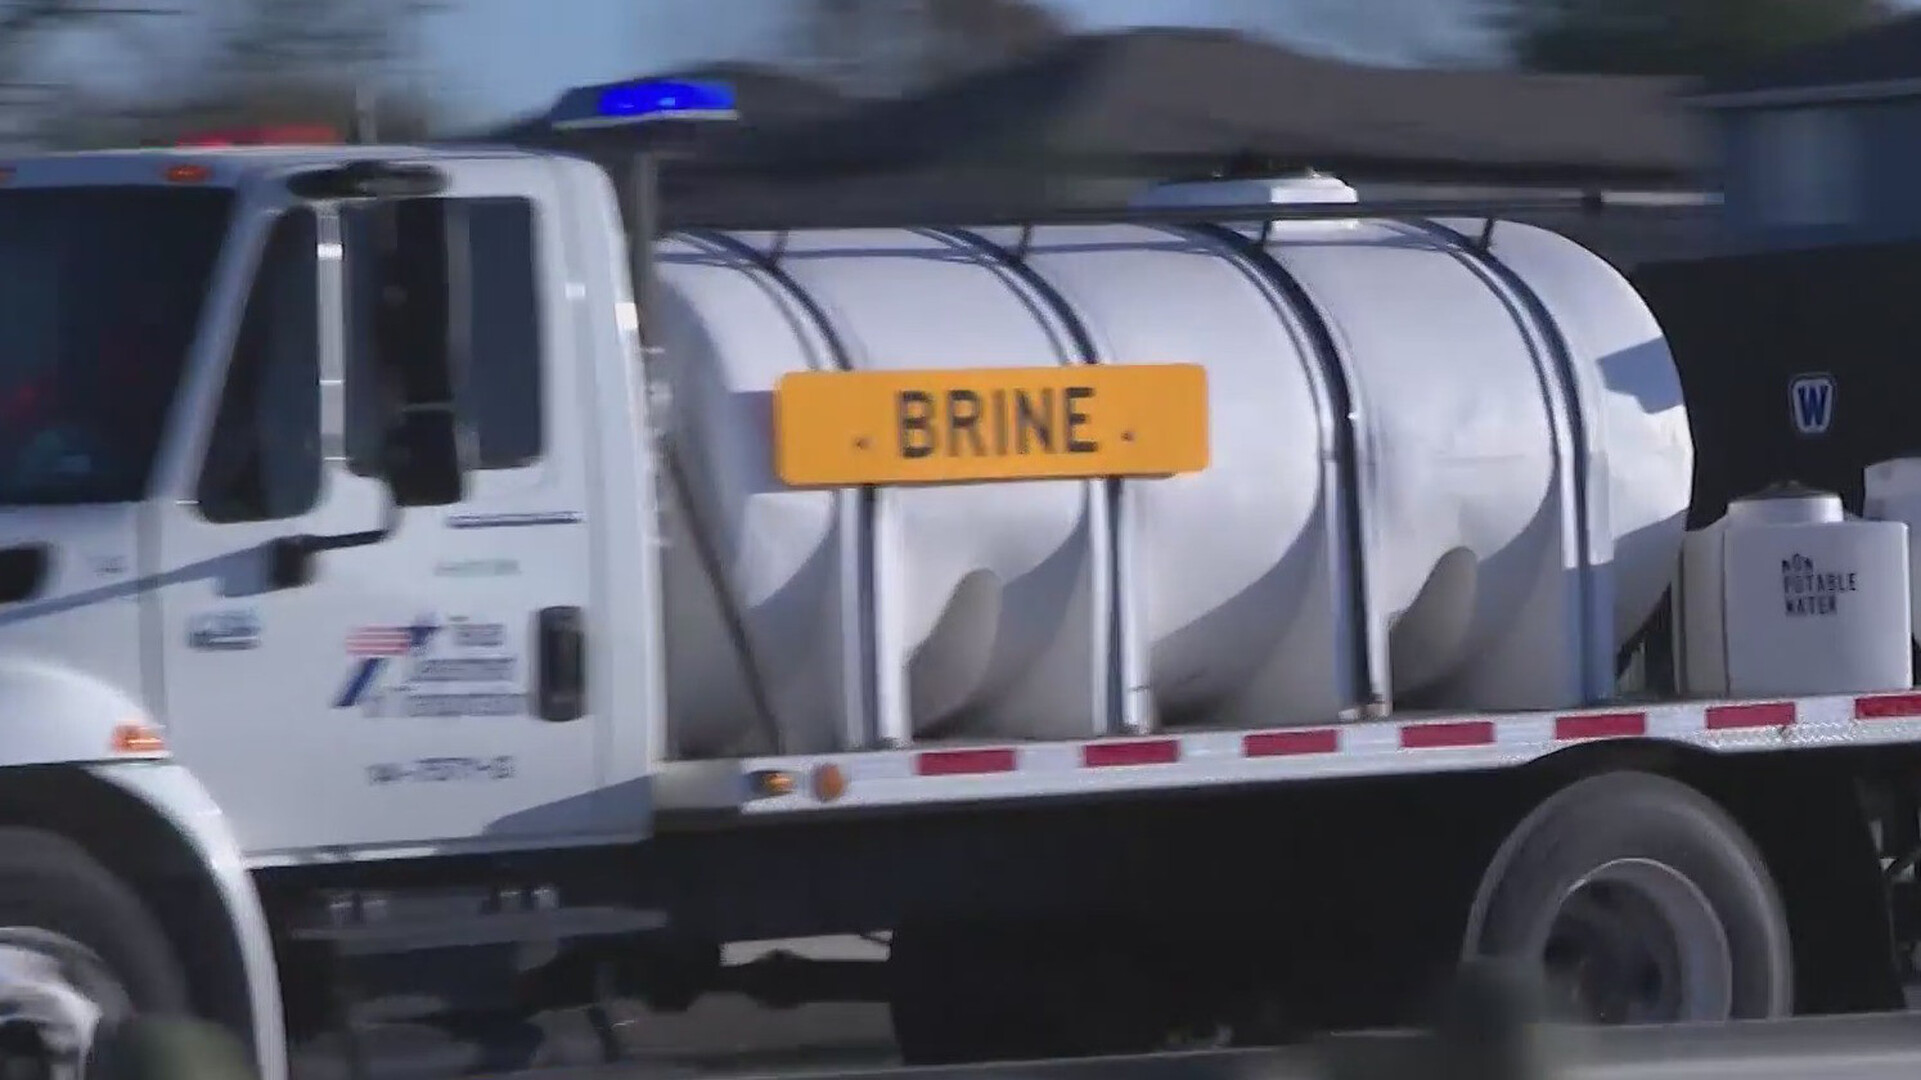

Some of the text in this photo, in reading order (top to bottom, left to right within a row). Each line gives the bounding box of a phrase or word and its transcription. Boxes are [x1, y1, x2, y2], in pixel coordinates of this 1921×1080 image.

[1797, 384, 1829, 427] W
[896, 386, 1098, 458] BRINE
[1783, 573, 1857, 594] POTABLE
[1785, 596, 1838, 616] WATER
